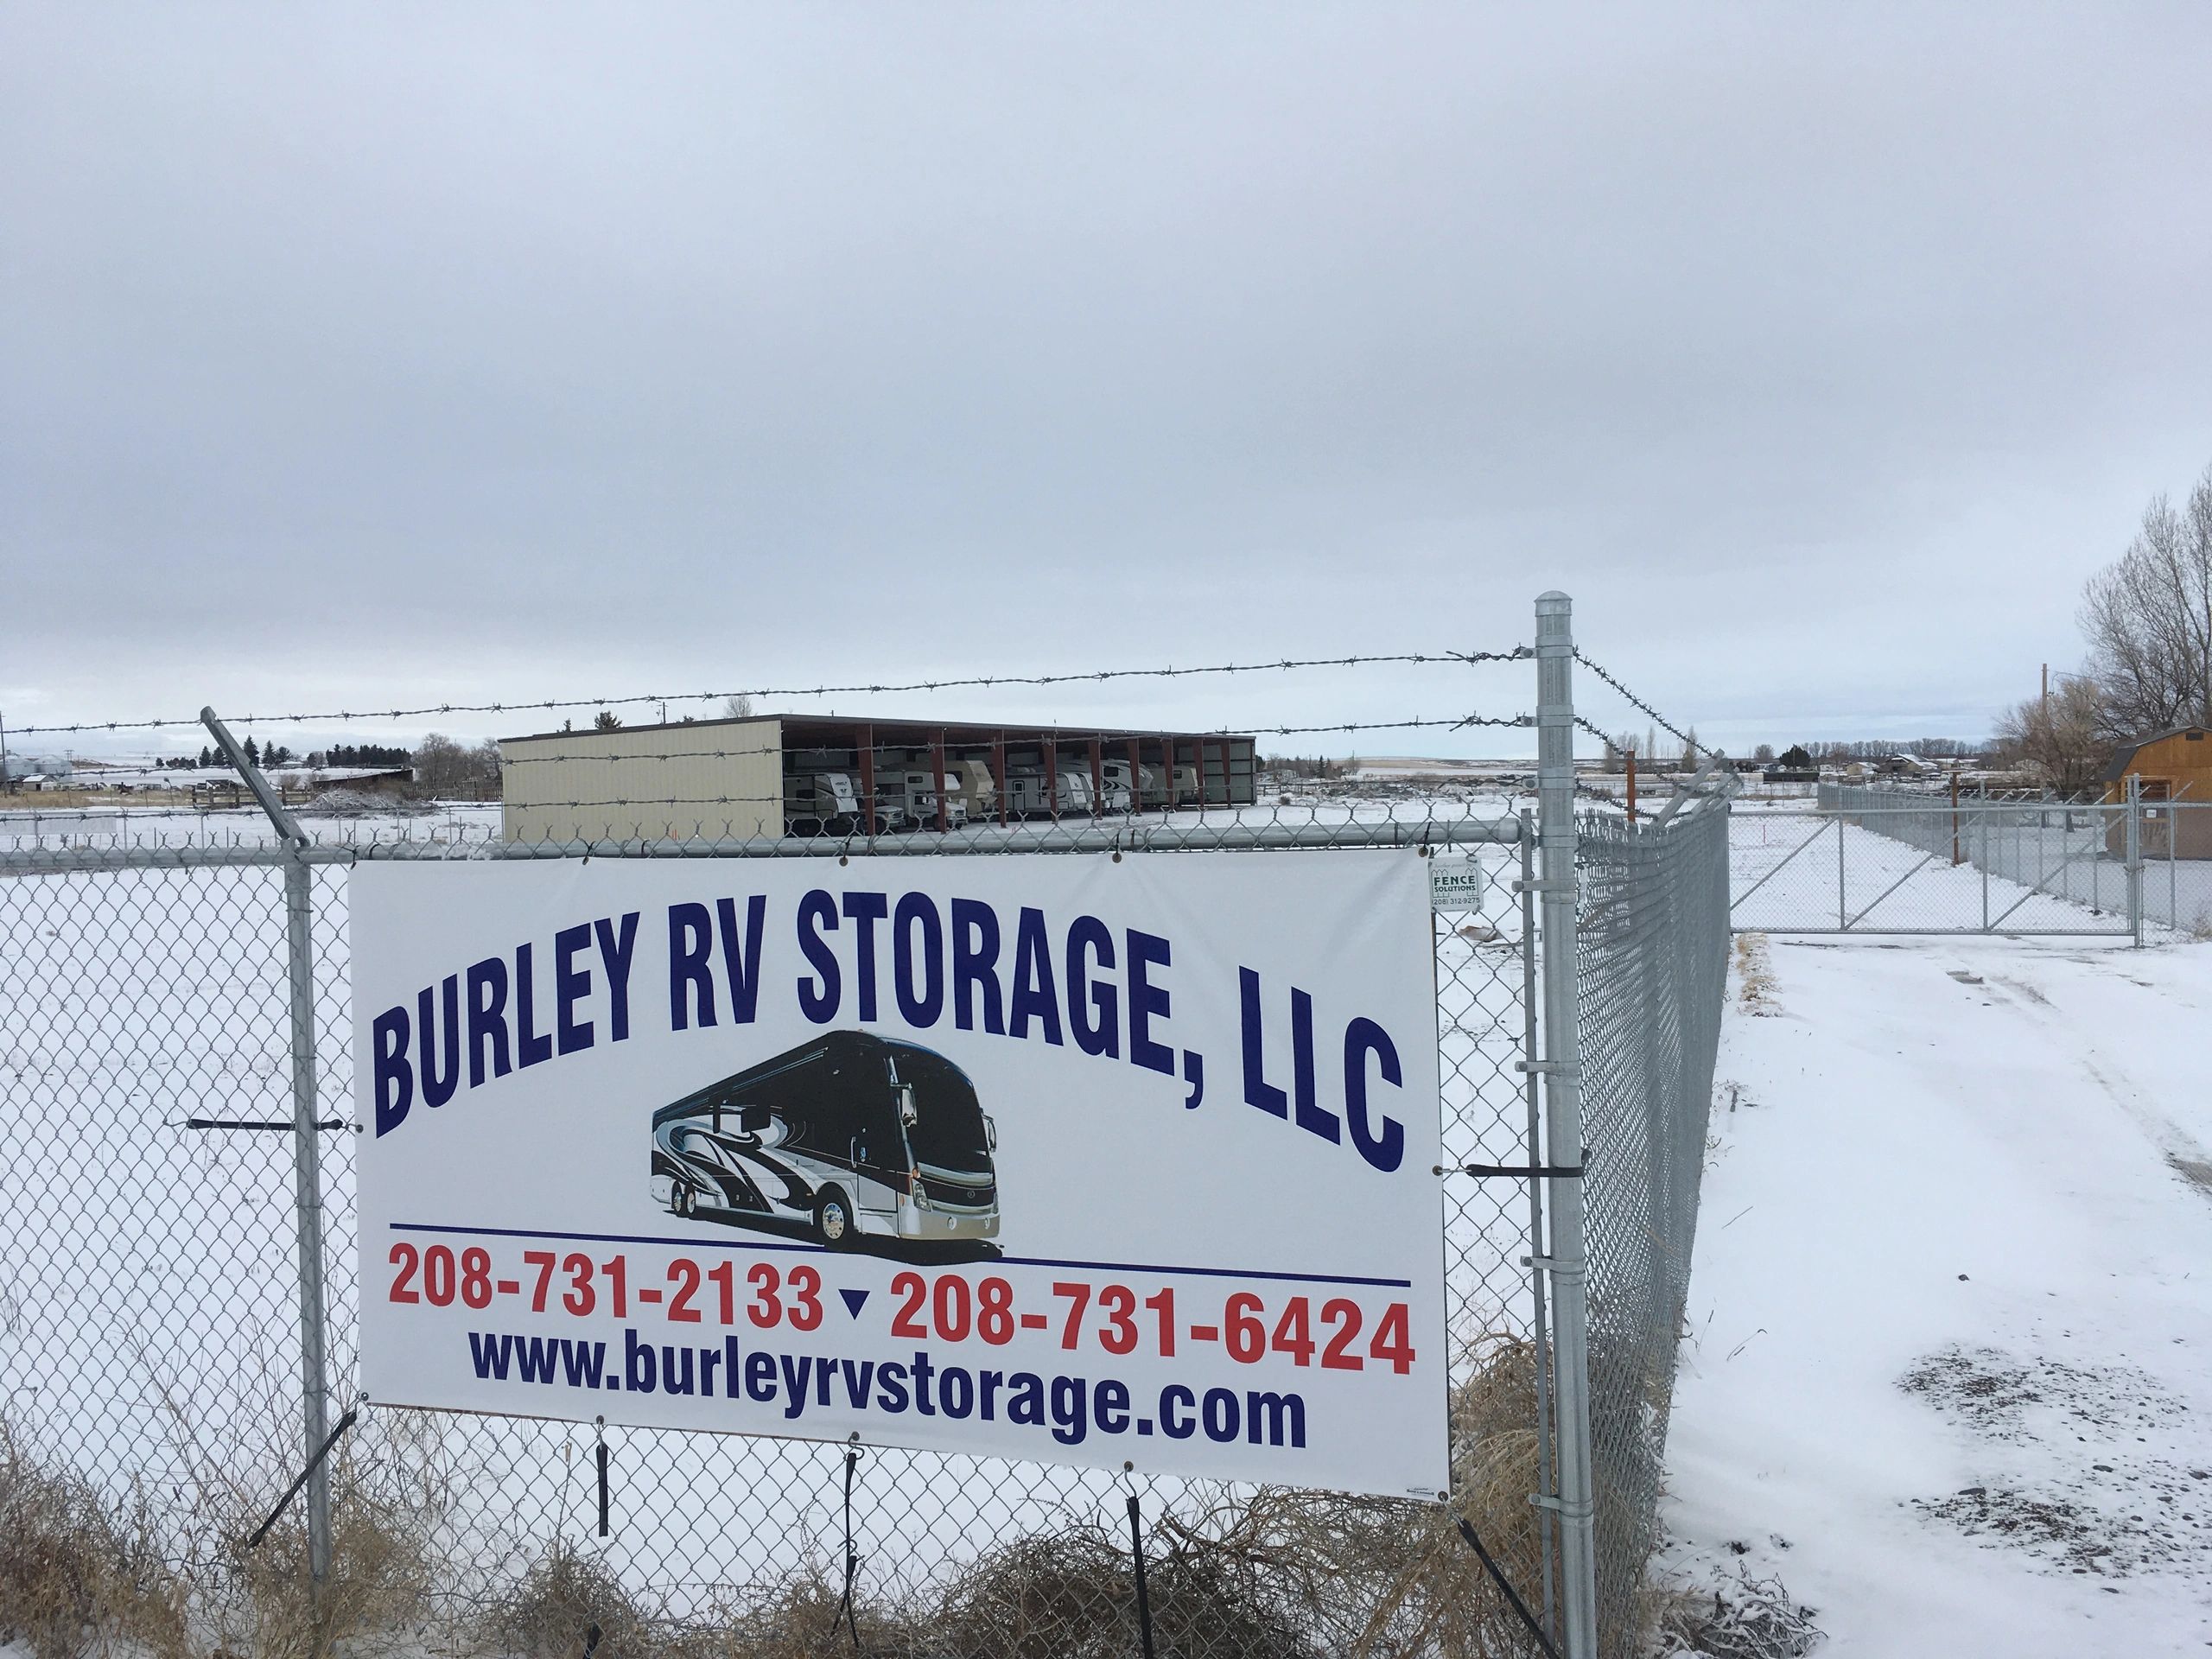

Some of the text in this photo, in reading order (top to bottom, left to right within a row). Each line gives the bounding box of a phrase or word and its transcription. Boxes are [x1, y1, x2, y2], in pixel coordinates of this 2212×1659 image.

[1433, 875, 1476, 886] FENCE
[372, 889, 1404, 1173] BURLEY RV STORAGE, LLC
[391, 1243, 1414, 1374] 208-731-2133 208-731-6424
[467, 1328, 1306, 1449] www.burleyrvstorage.com
